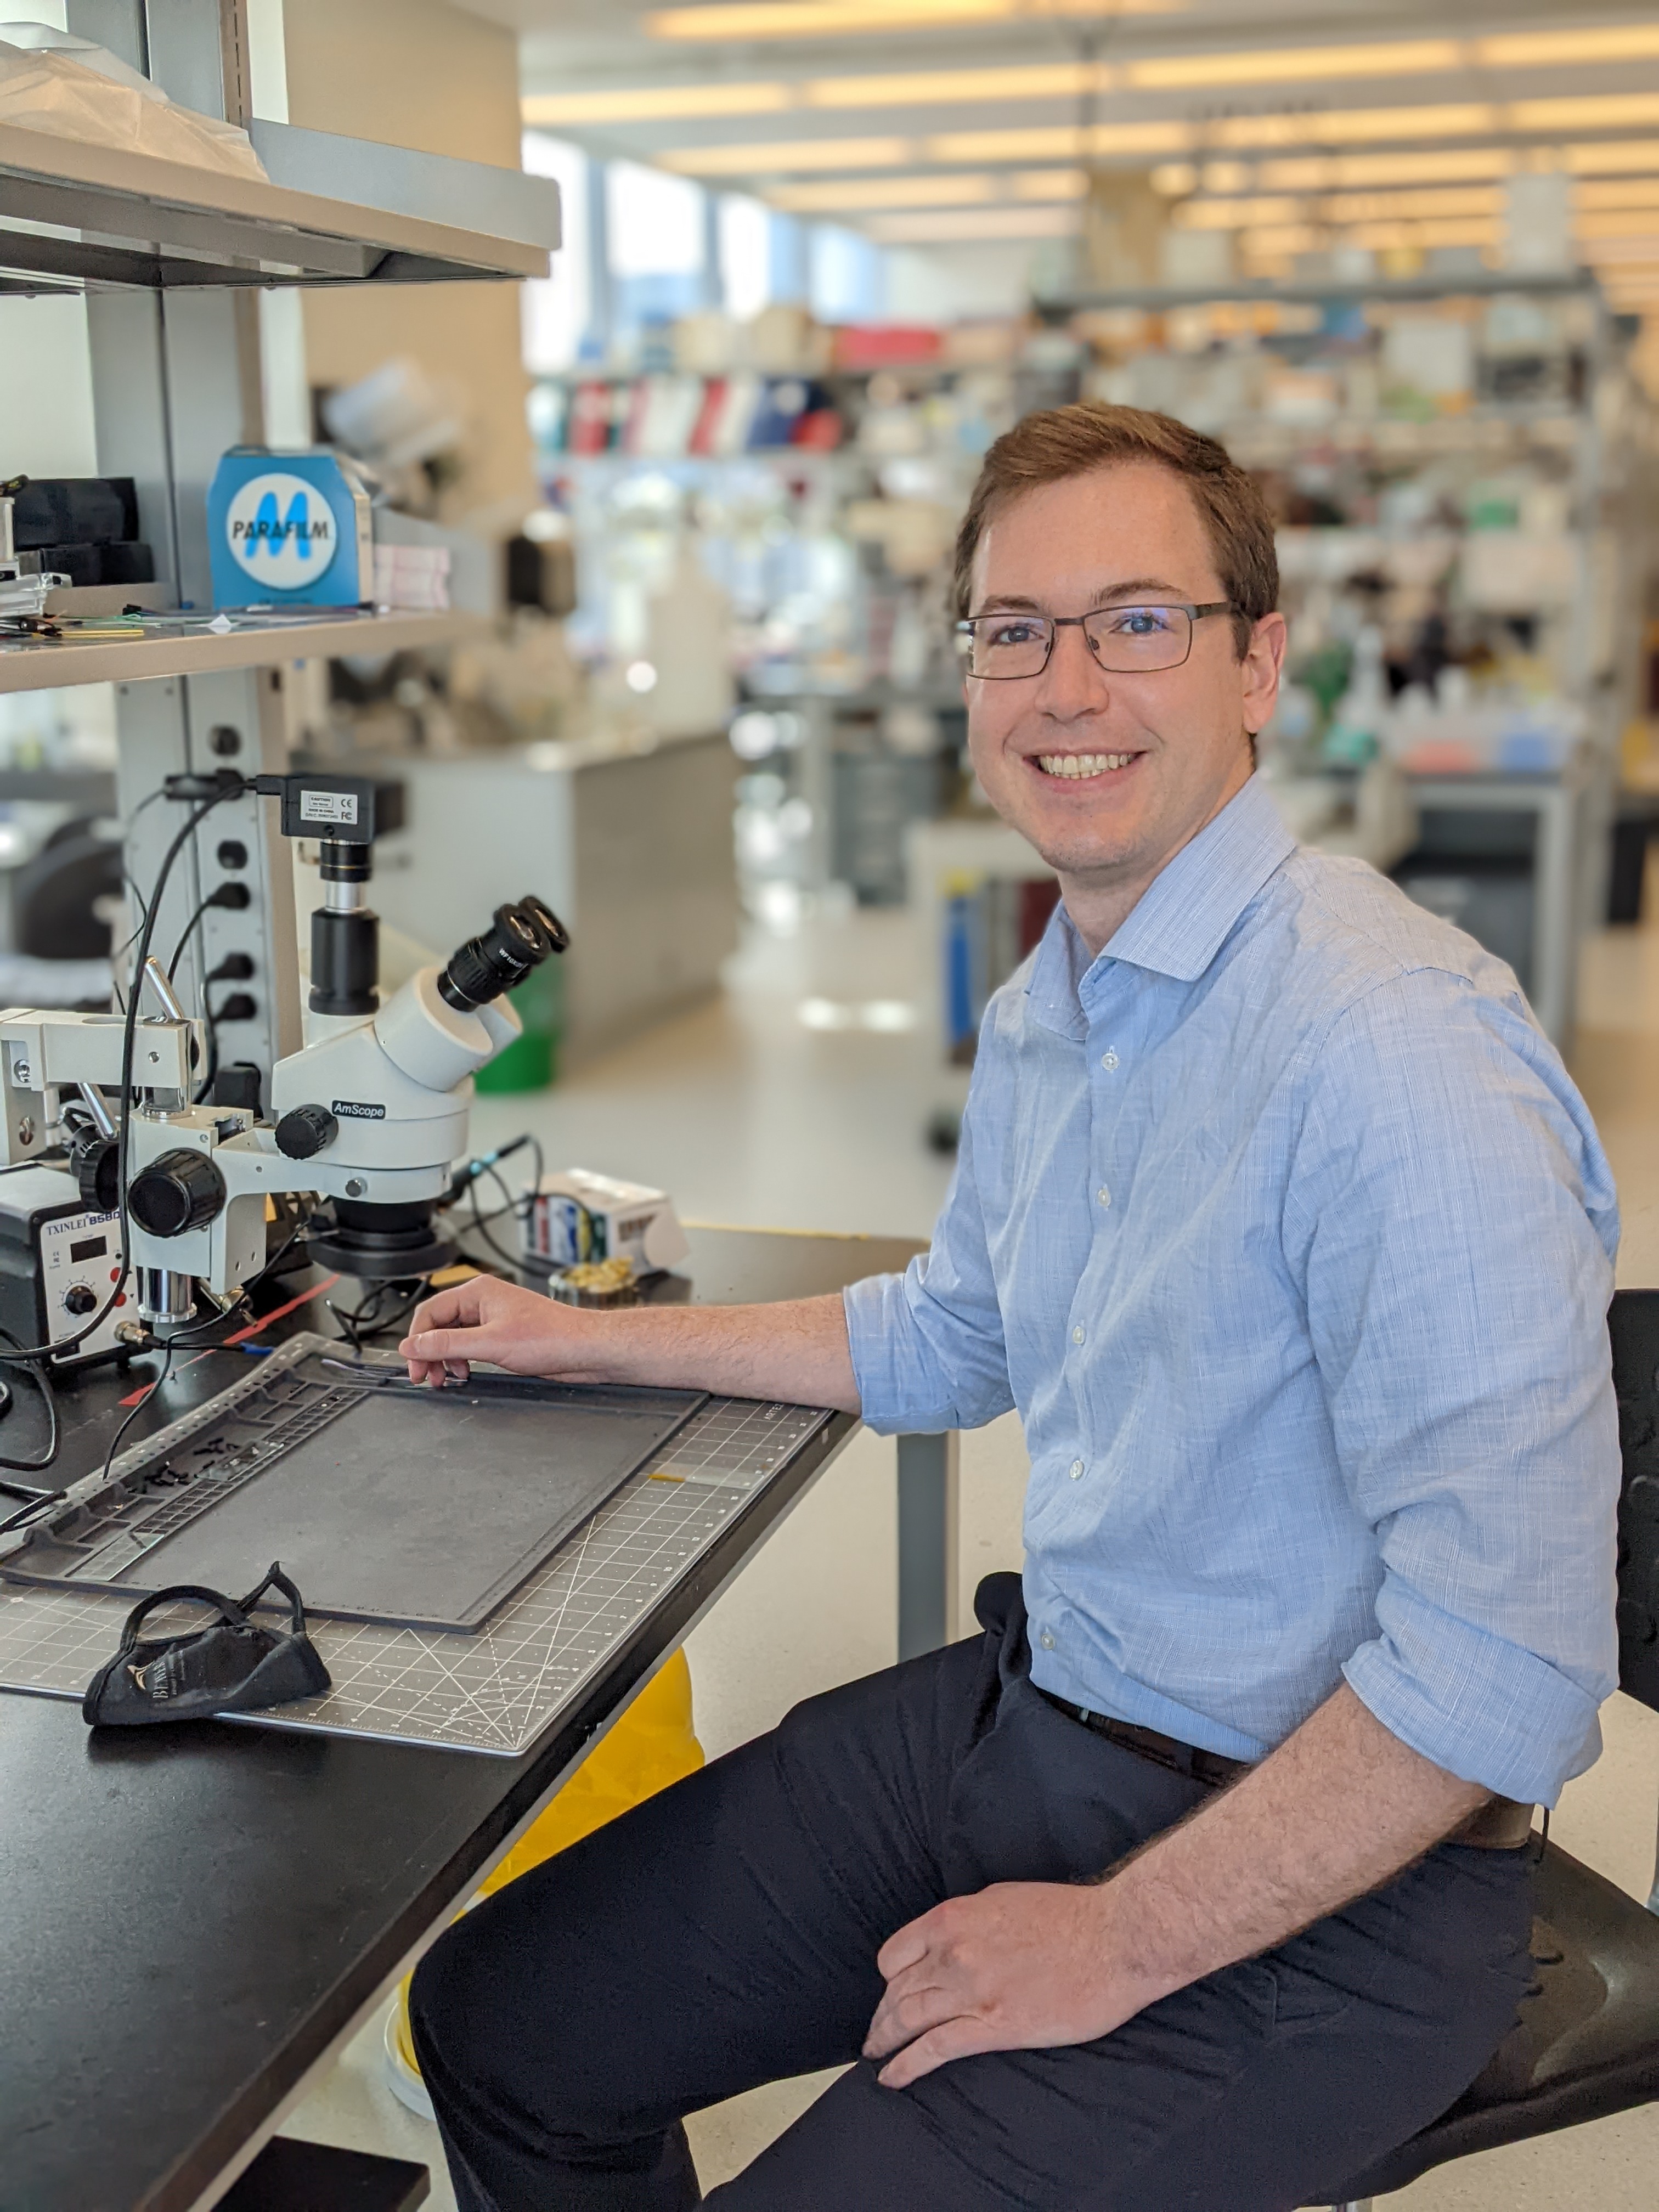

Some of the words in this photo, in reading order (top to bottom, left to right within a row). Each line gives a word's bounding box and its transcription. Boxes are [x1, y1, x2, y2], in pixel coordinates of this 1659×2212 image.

[233, 521, 329, 539] PARAFILM
[334, 1102, 384, 1118] AmScope
[47, 1218, 86, 1235] TXINLEI
